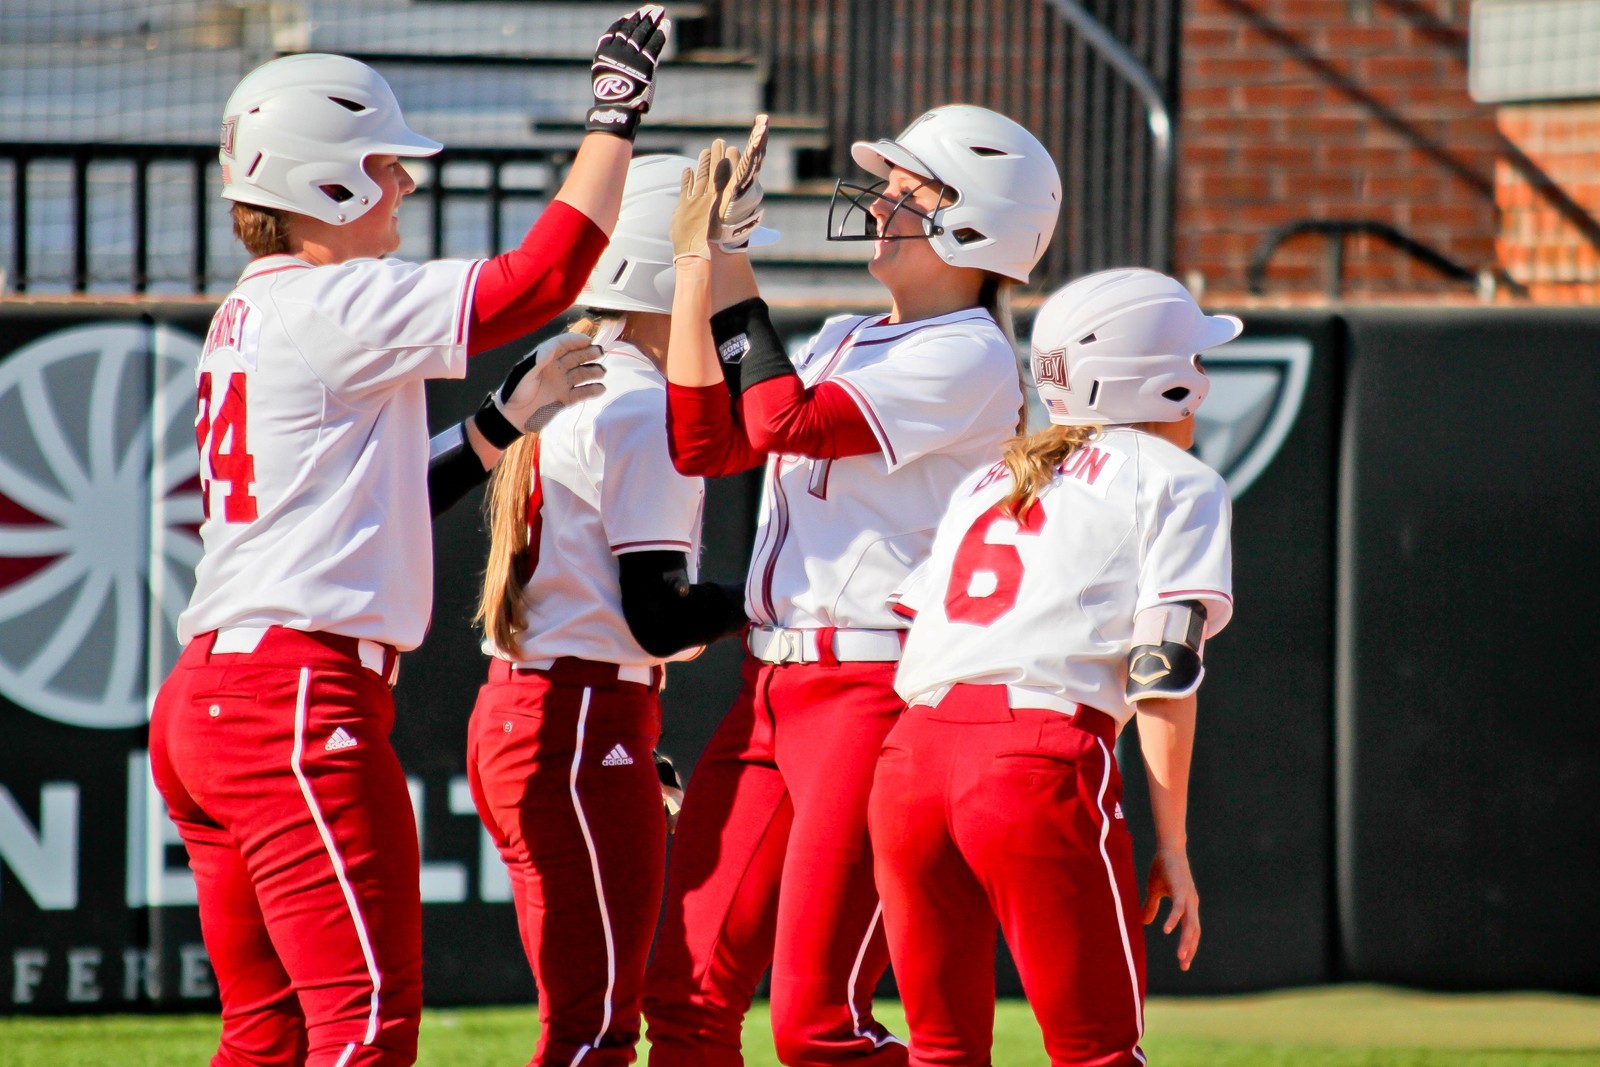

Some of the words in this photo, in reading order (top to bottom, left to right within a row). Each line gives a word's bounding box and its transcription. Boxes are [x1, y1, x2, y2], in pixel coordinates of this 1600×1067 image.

[943, 497, 1048, 628] 6
[325, 738, 358, 751] adidas
[602, 757, 634, 767] adidas
